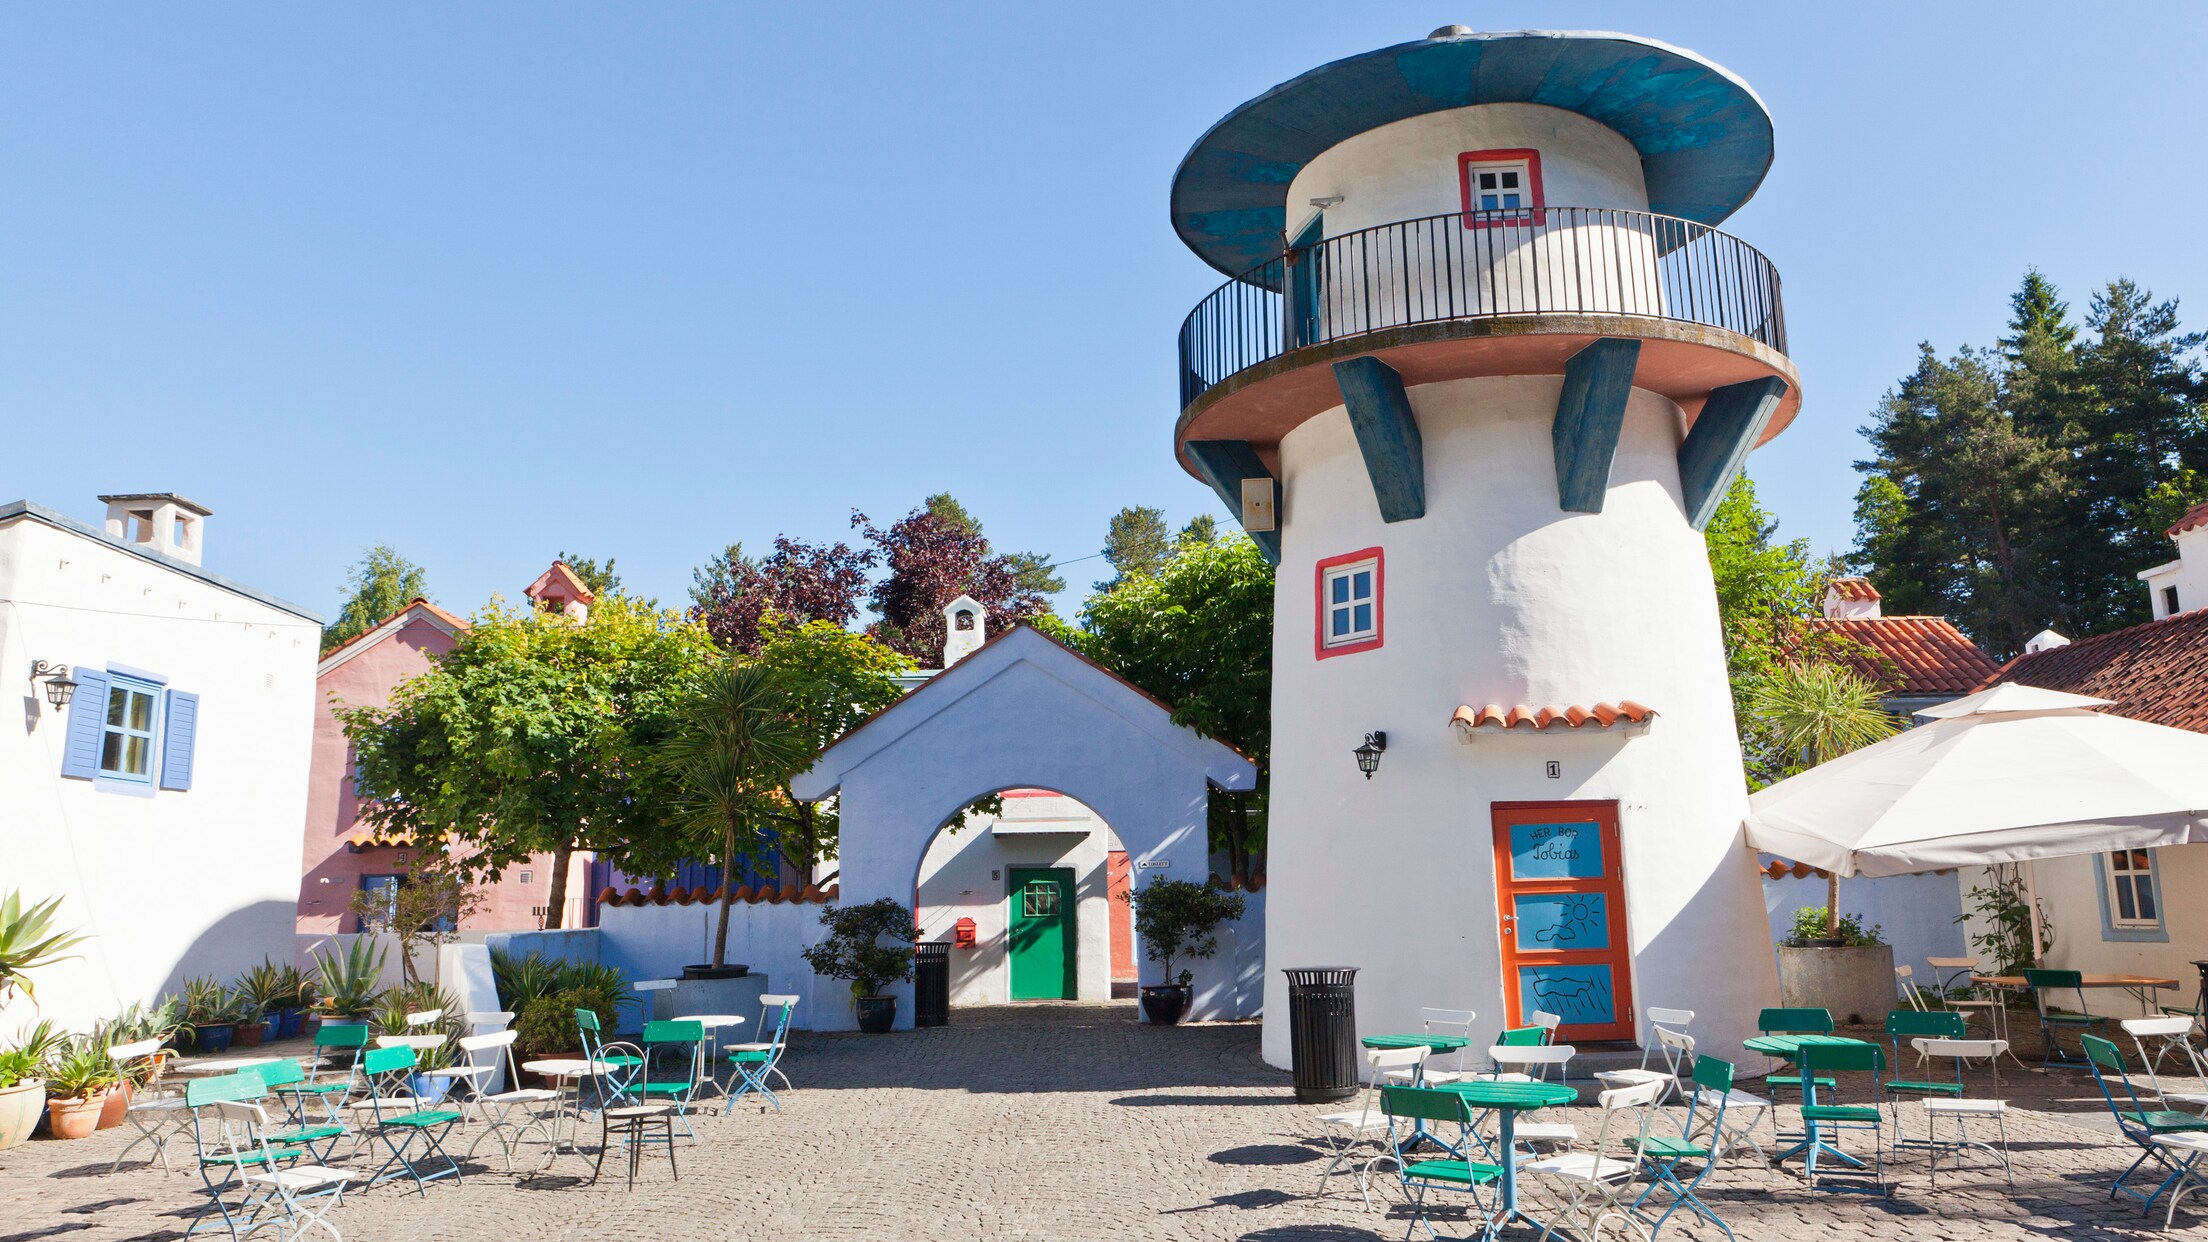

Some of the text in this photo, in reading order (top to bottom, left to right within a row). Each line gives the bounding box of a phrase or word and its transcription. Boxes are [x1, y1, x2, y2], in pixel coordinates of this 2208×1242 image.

[1549, 763, 1557, 776] 1
[1529, 826, 1579, 840] HER BOR
[1533, 842, 1580, 860] Tobias
